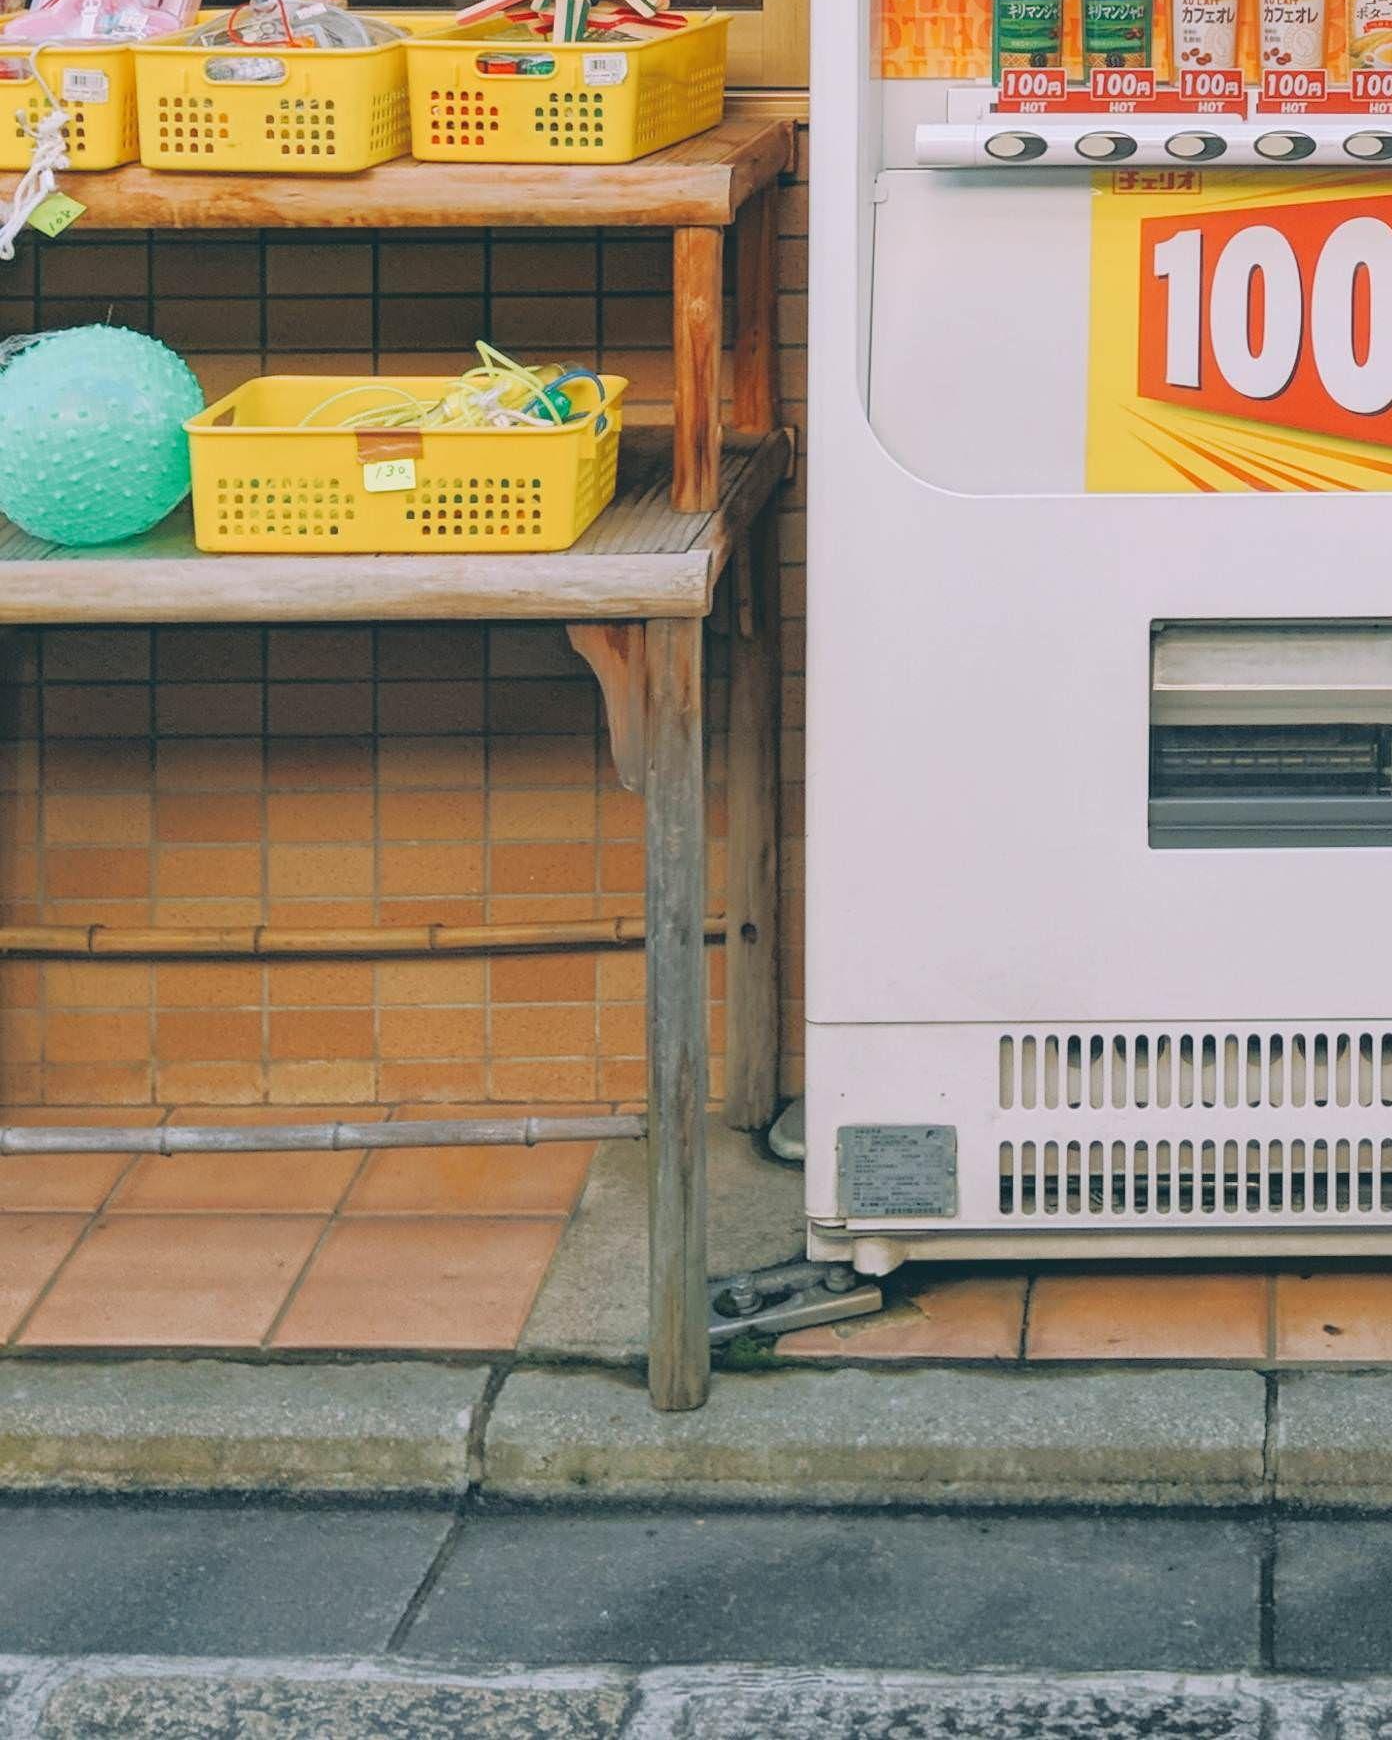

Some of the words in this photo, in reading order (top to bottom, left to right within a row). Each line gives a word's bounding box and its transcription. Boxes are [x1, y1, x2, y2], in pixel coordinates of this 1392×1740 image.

[1008, 3, 1061, 20] キリマンジャ
[1087, 3, 1145, 21] キリマンジャロ
[1182, 7, 1236, 24] カフェオレ
[1263, 7, 1319, 24] カフェオレ
[1005, 74, 1062, 96] 100円
[1094, 74, 1151, 96] 100円
[1184, 74, 1240, 96] 100円
[1266, 74, 1323, 96] 100円
[1020, 102, 1047, 113] HOT
[1109, 102, 1136, 113] HOT
[1198, 102, 1225, 113] HOT
[1281, 102, 1308, 114] HOT
[1118, 171, 1195, 191] チェリオ
